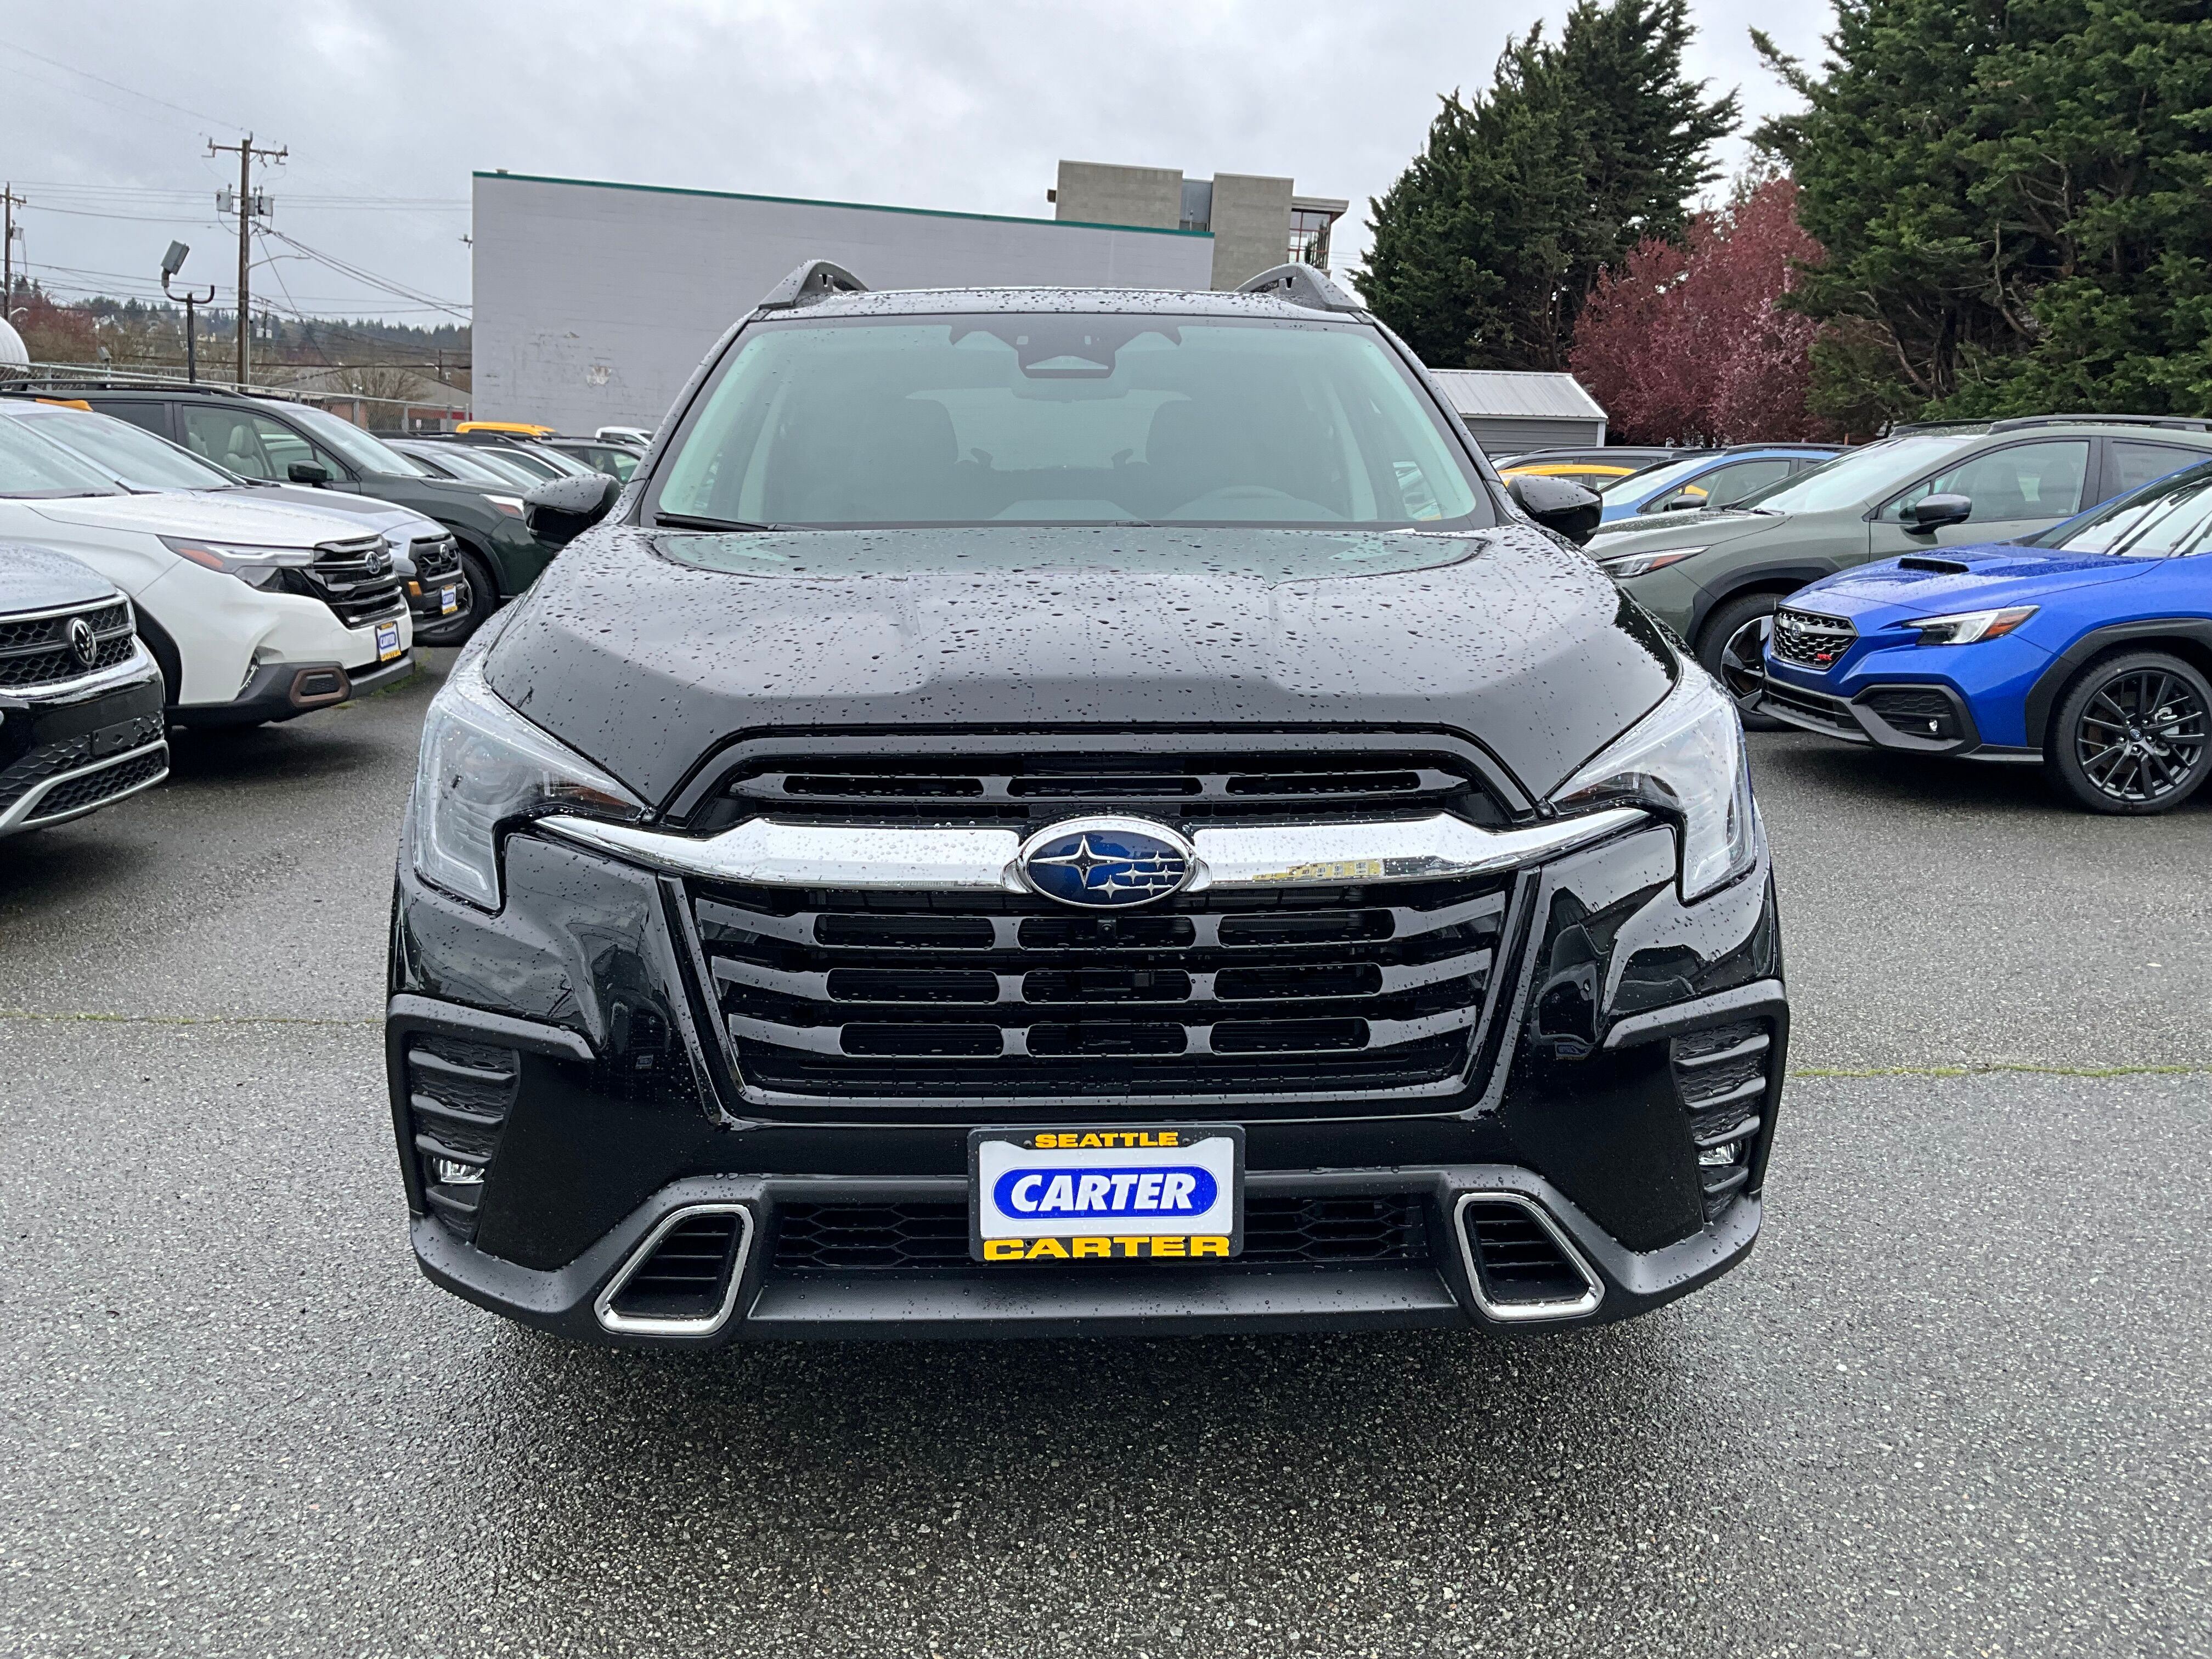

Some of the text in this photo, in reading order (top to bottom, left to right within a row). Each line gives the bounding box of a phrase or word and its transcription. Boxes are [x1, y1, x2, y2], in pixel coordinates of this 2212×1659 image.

[1035, 1132, 1178, 1148] SEATTLE
[1011, 1173, 1196, 1212] CARTER
[983, 1236, 1229, 1260] CARTER
